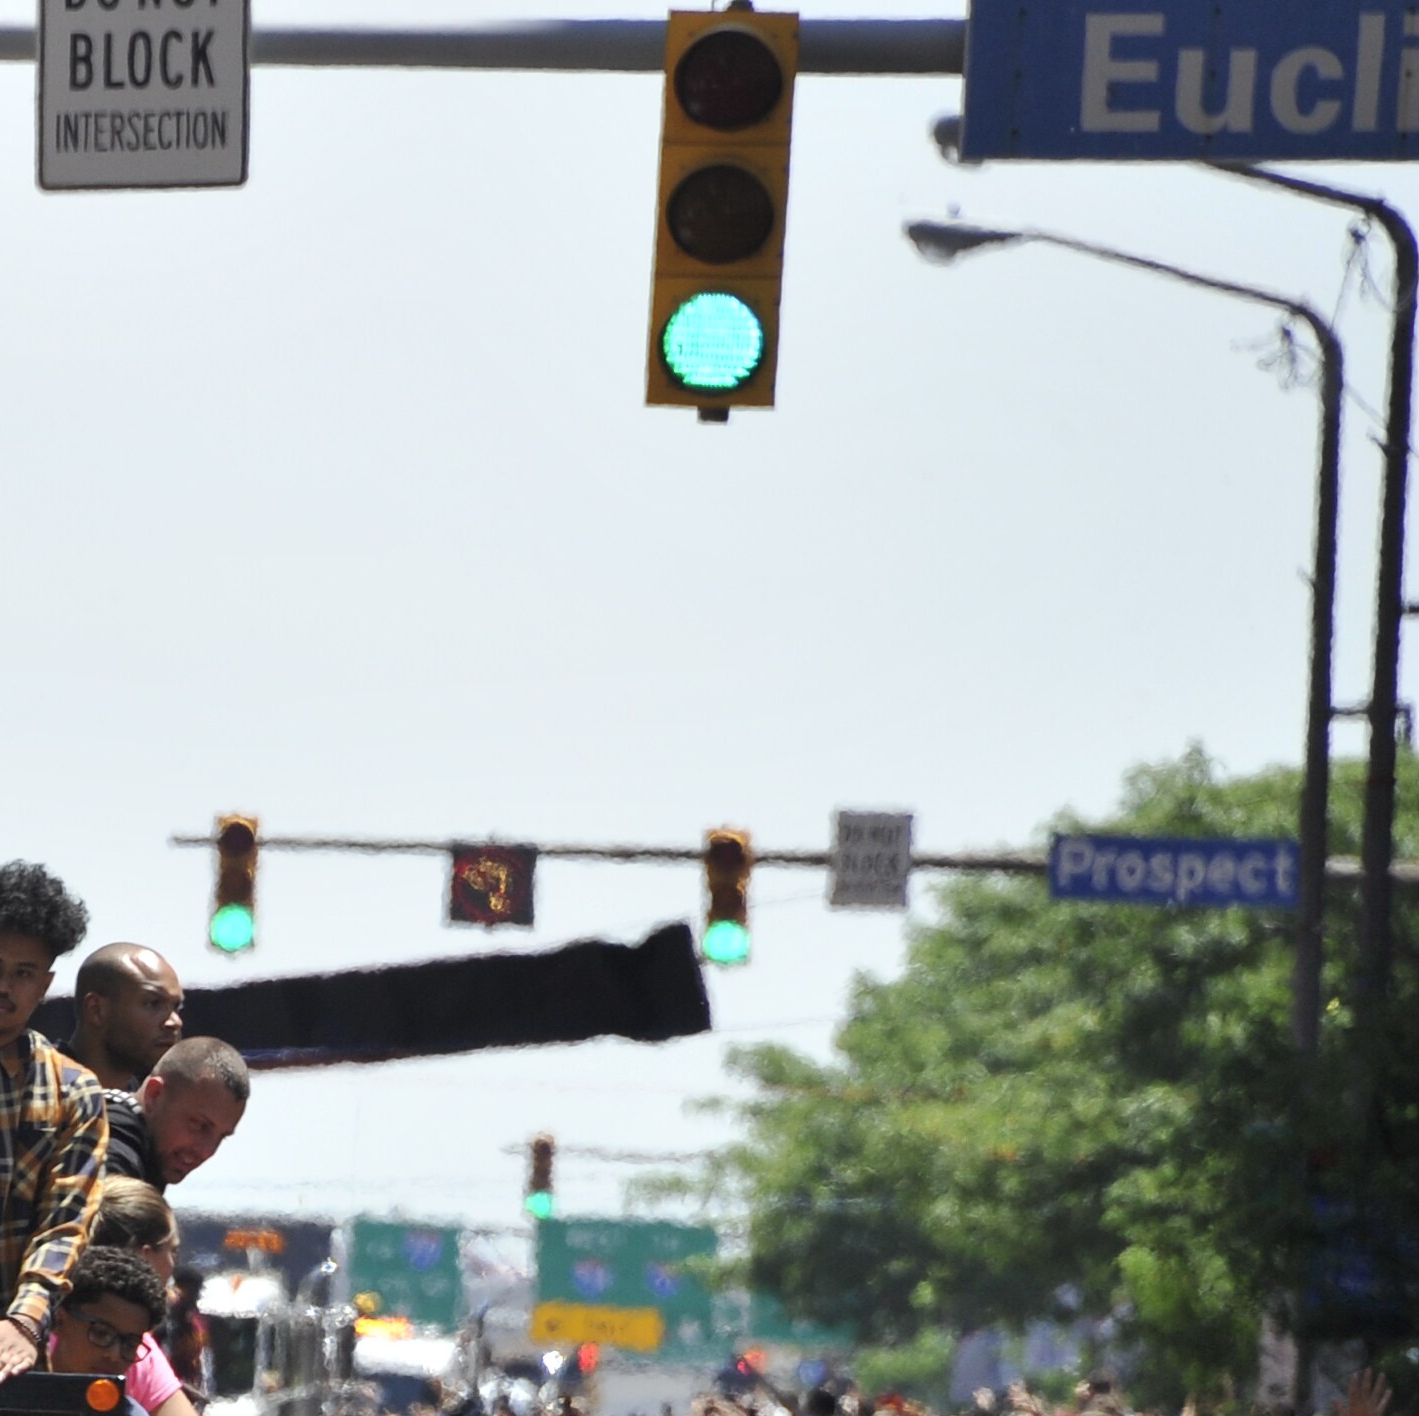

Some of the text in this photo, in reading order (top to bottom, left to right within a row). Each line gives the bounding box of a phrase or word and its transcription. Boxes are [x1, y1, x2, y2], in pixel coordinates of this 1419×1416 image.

[69, 29, 216, 91] BLOCK
[55, 110, 229, 153] INTERSECTION
[1057, 838, 1293, 901] Prospect
